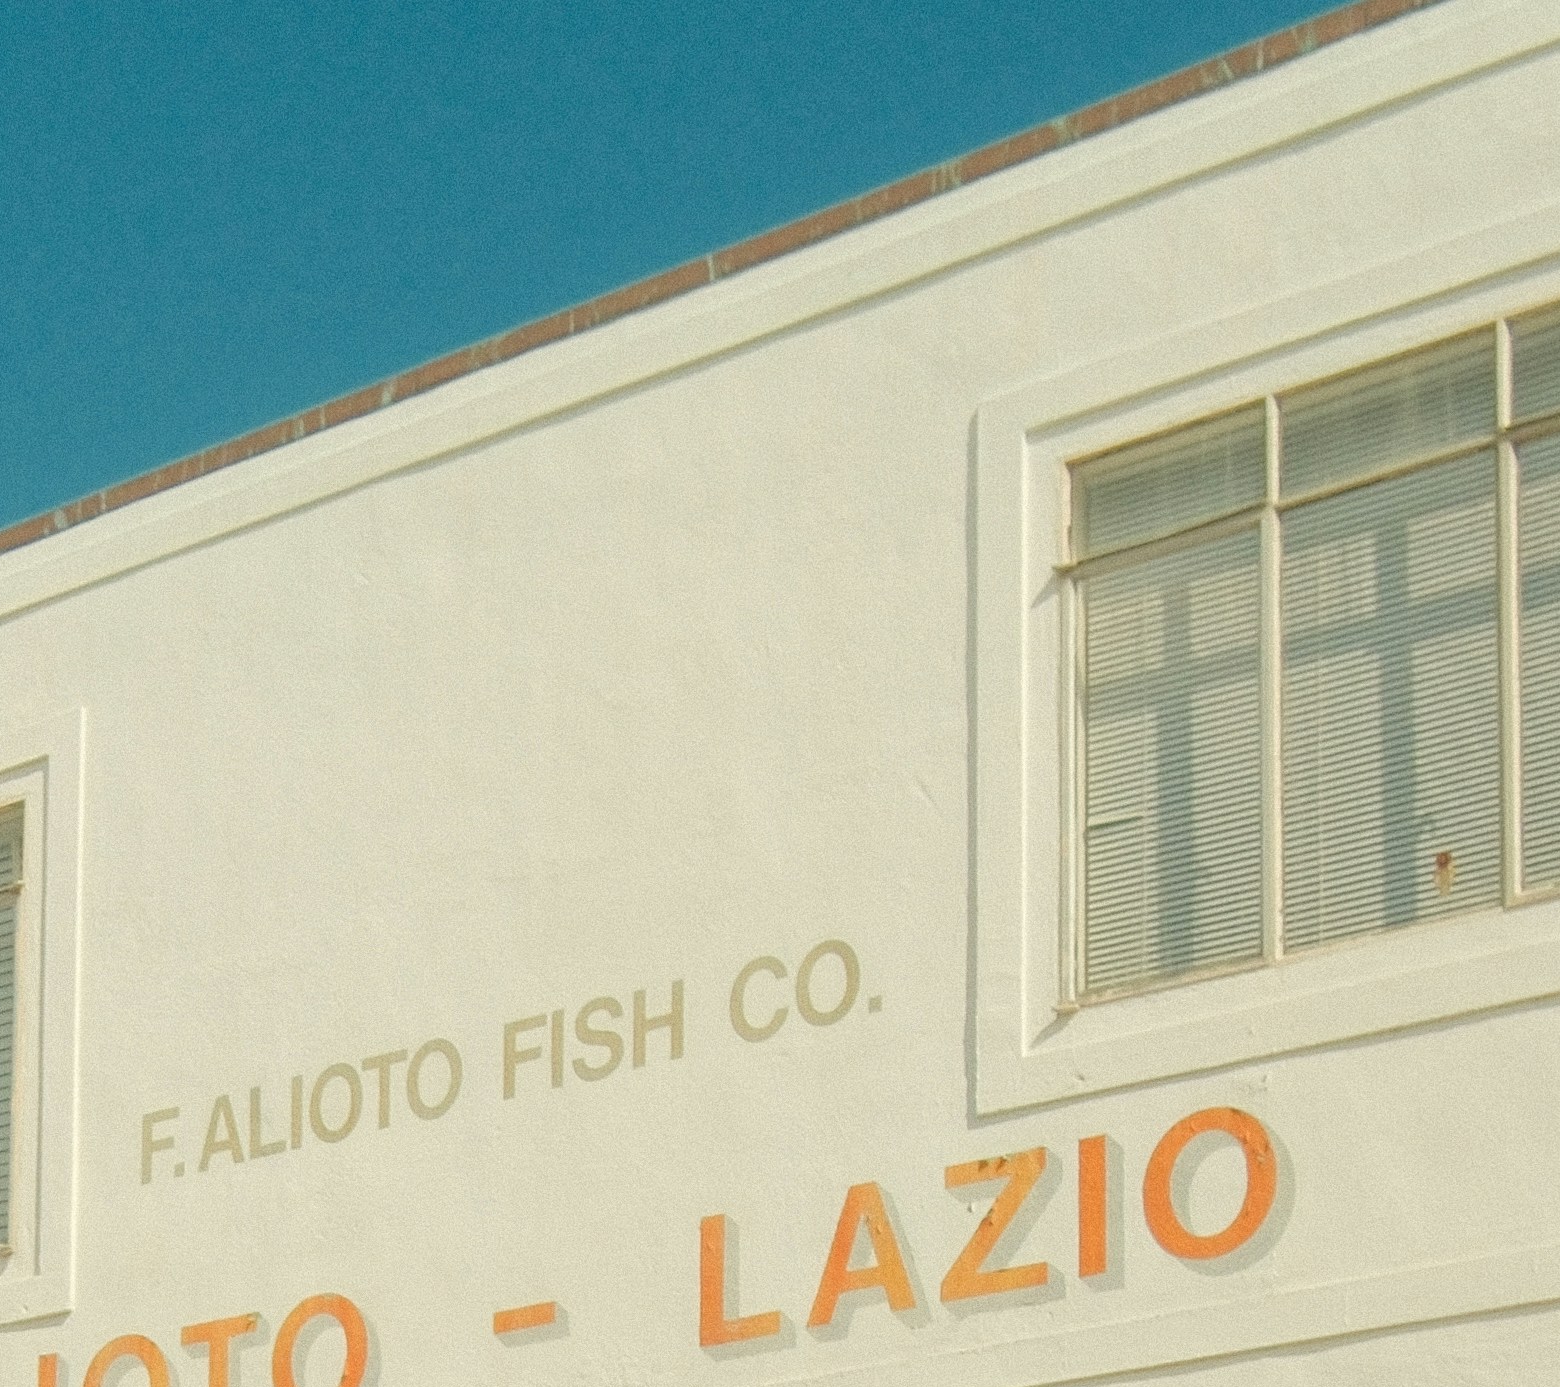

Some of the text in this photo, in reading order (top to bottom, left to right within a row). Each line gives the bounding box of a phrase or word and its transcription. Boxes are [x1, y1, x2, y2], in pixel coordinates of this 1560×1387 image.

[503, 980, 684, 1100] FISH
[729, 938, 883, 1043] CO.
[700, 1106, 1277, 1348] LAZIO
